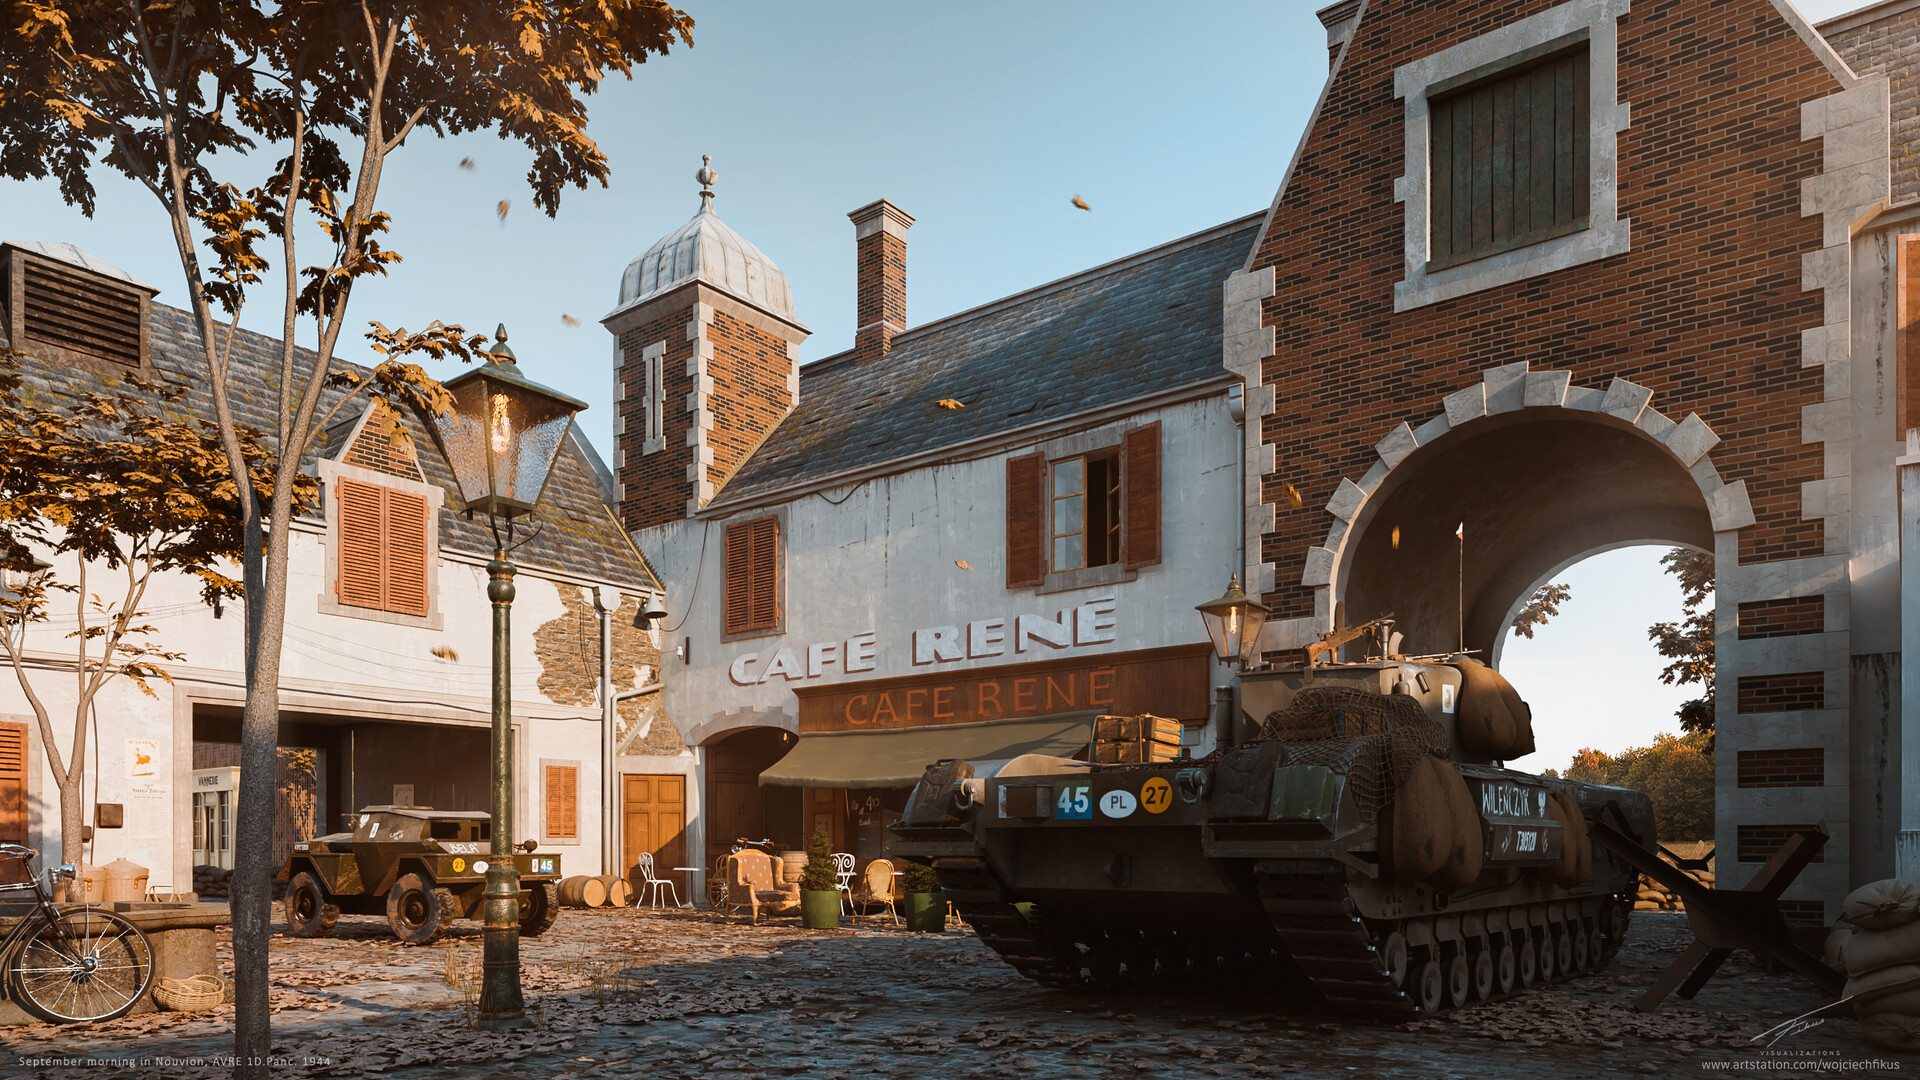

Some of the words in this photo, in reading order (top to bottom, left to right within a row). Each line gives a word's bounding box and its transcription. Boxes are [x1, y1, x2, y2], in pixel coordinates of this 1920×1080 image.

[729, 628, 876, 687] CAFÉ
[912, 593, 1117, 667] RENÉ
[845, 686, 956, 725] CAFE
[977, 665, 1117, 714] RENÉ
[1057, 786, 1090, 813] 45
[1110, 795, 1128, 809] PL
[1145, 785, 1169, 805] 27
[454, 861, 464, 869] 27
[540, 860, 553, 871] 45
